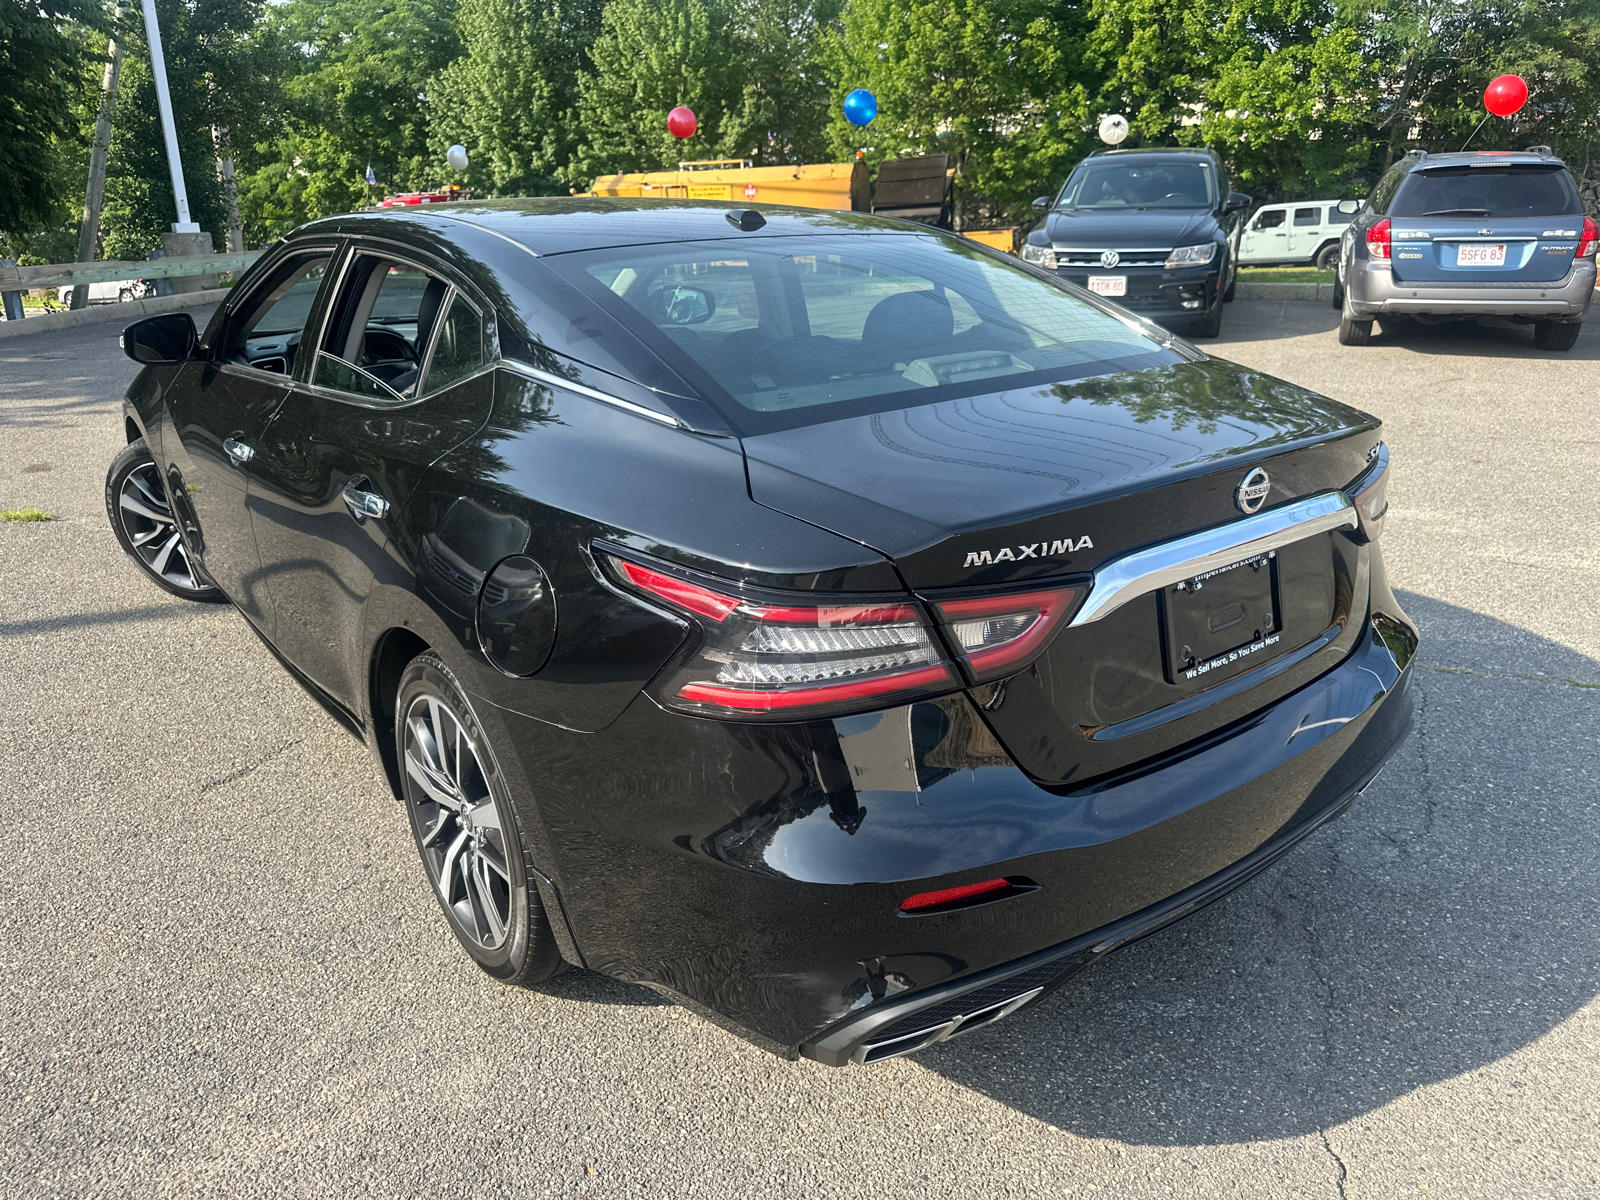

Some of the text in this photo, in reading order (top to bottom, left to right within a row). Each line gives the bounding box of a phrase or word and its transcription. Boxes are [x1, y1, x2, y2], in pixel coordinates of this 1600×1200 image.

[1461, 249, 1504, 260] 5SFG 83
[1112, 281, 1123, 291] 80
[1244, 485, 1269, 498] NISSAN
[963, 535, 1094, 568] MAXIMA
[1186, 635, 1280, 680] We Sell More, So You Save More
